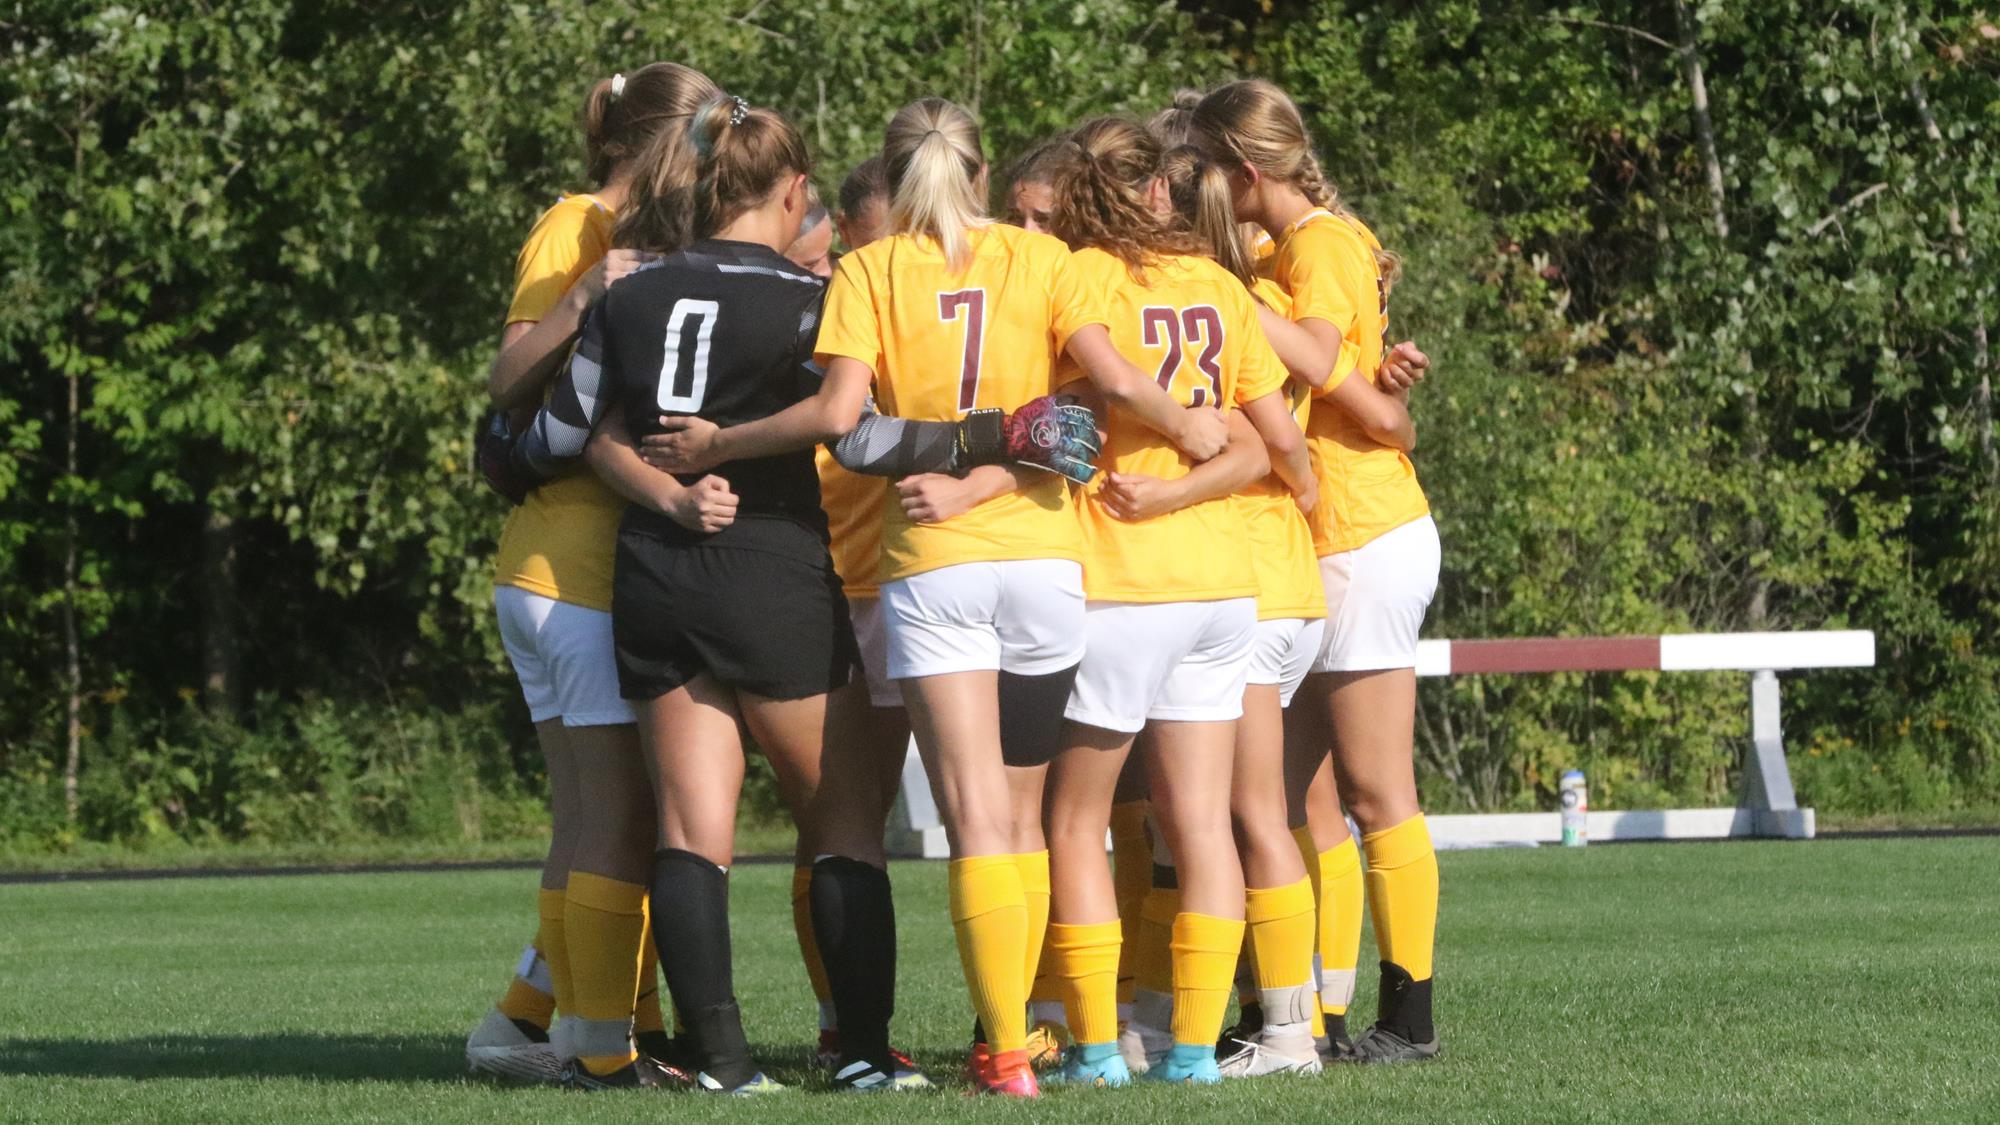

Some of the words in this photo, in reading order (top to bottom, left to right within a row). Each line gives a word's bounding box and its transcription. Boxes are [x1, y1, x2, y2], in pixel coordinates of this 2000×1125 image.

[657, 298, 719, 413] 0
[937, 288, 985, 413] 7
[1142, 305, 1224, 409] 23
[971, 408, 1000, 416] ALOHA
